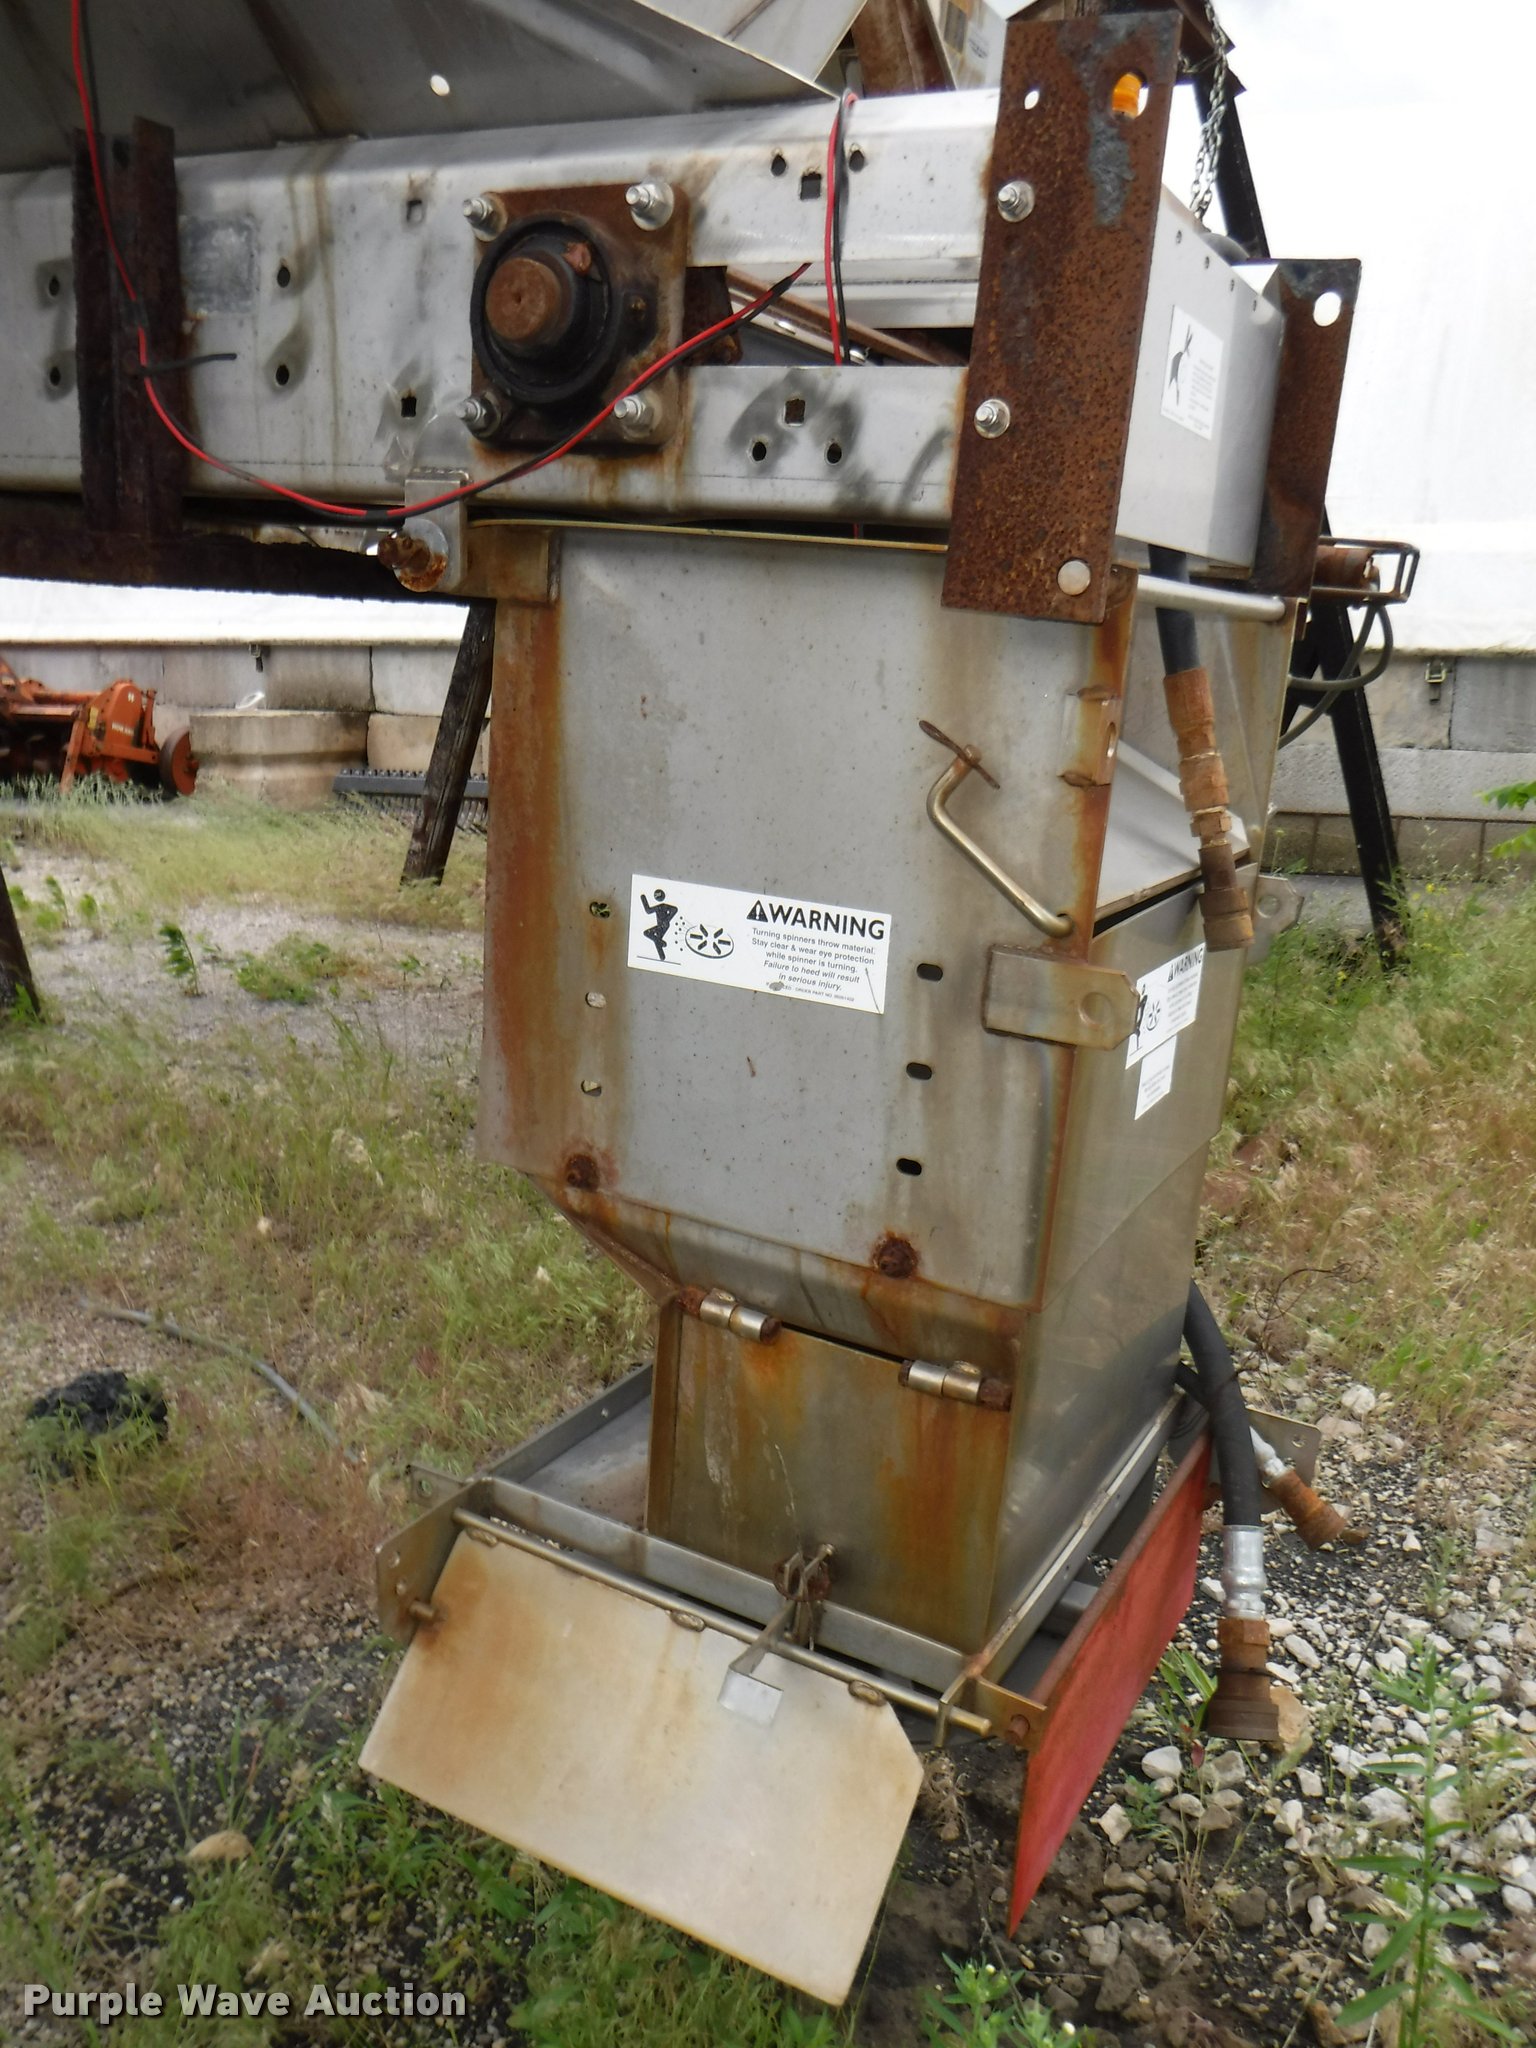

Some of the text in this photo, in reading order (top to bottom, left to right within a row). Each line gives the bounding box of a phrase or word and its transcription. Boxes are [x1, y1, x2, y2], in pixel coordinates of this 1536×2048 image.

[769, 903, 885, 940] WARNING
[752, 928, 875, 955] Turning spinners throw material.
[752, 938, 768, 947] Stay
[770, 941, 788, 950] clear
[799, 947, 816, 955] wear
[834, 951, 874, 965] protection
[764, 960, 789, 971] Failure
[801, 967, 820, 976] heed
[822, 970, 835, 978] will
[837, 973, 859, 983] result
[766, 951, 785, 960] while
[788, 955, 816, 965] spinner
[828, 962, 857, 973] turning.
[1174, 948, 1203, 975] WARNING
[788, 975, 816, 985] serious
[819, 980, 841, 991] injury.
